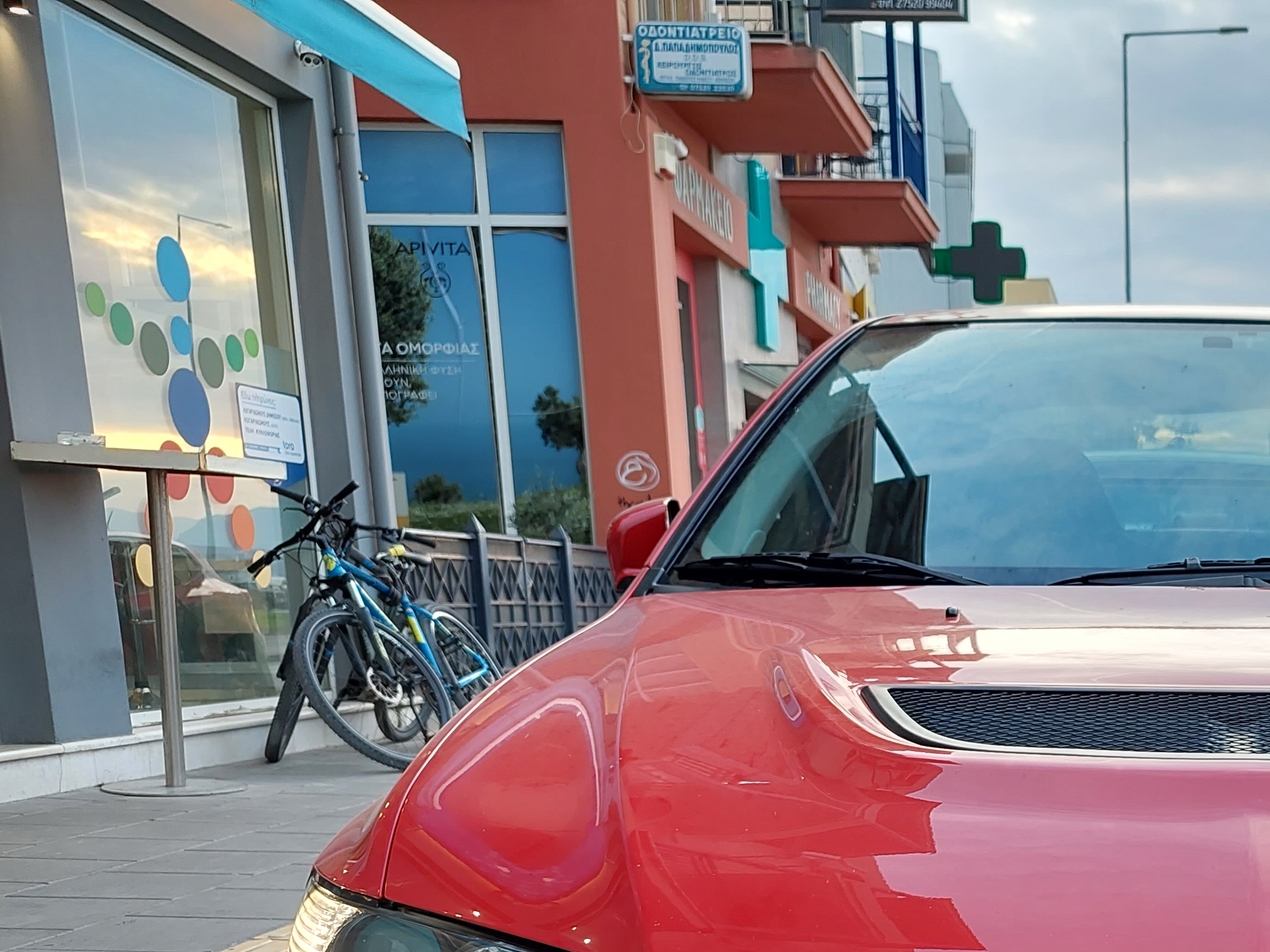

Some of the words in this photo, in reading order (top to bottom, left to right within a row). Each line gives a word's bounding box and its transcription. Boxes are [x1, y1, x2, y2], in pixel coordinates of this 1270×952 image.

[638, 25, 741, 39] ΟΔΟΝΤΙΑΤΡΕΙΟ
[395, 241, 471, 256] APIVITA
[395, 342, 480, 355] ΟΜΟΡΦΙΑΣ
